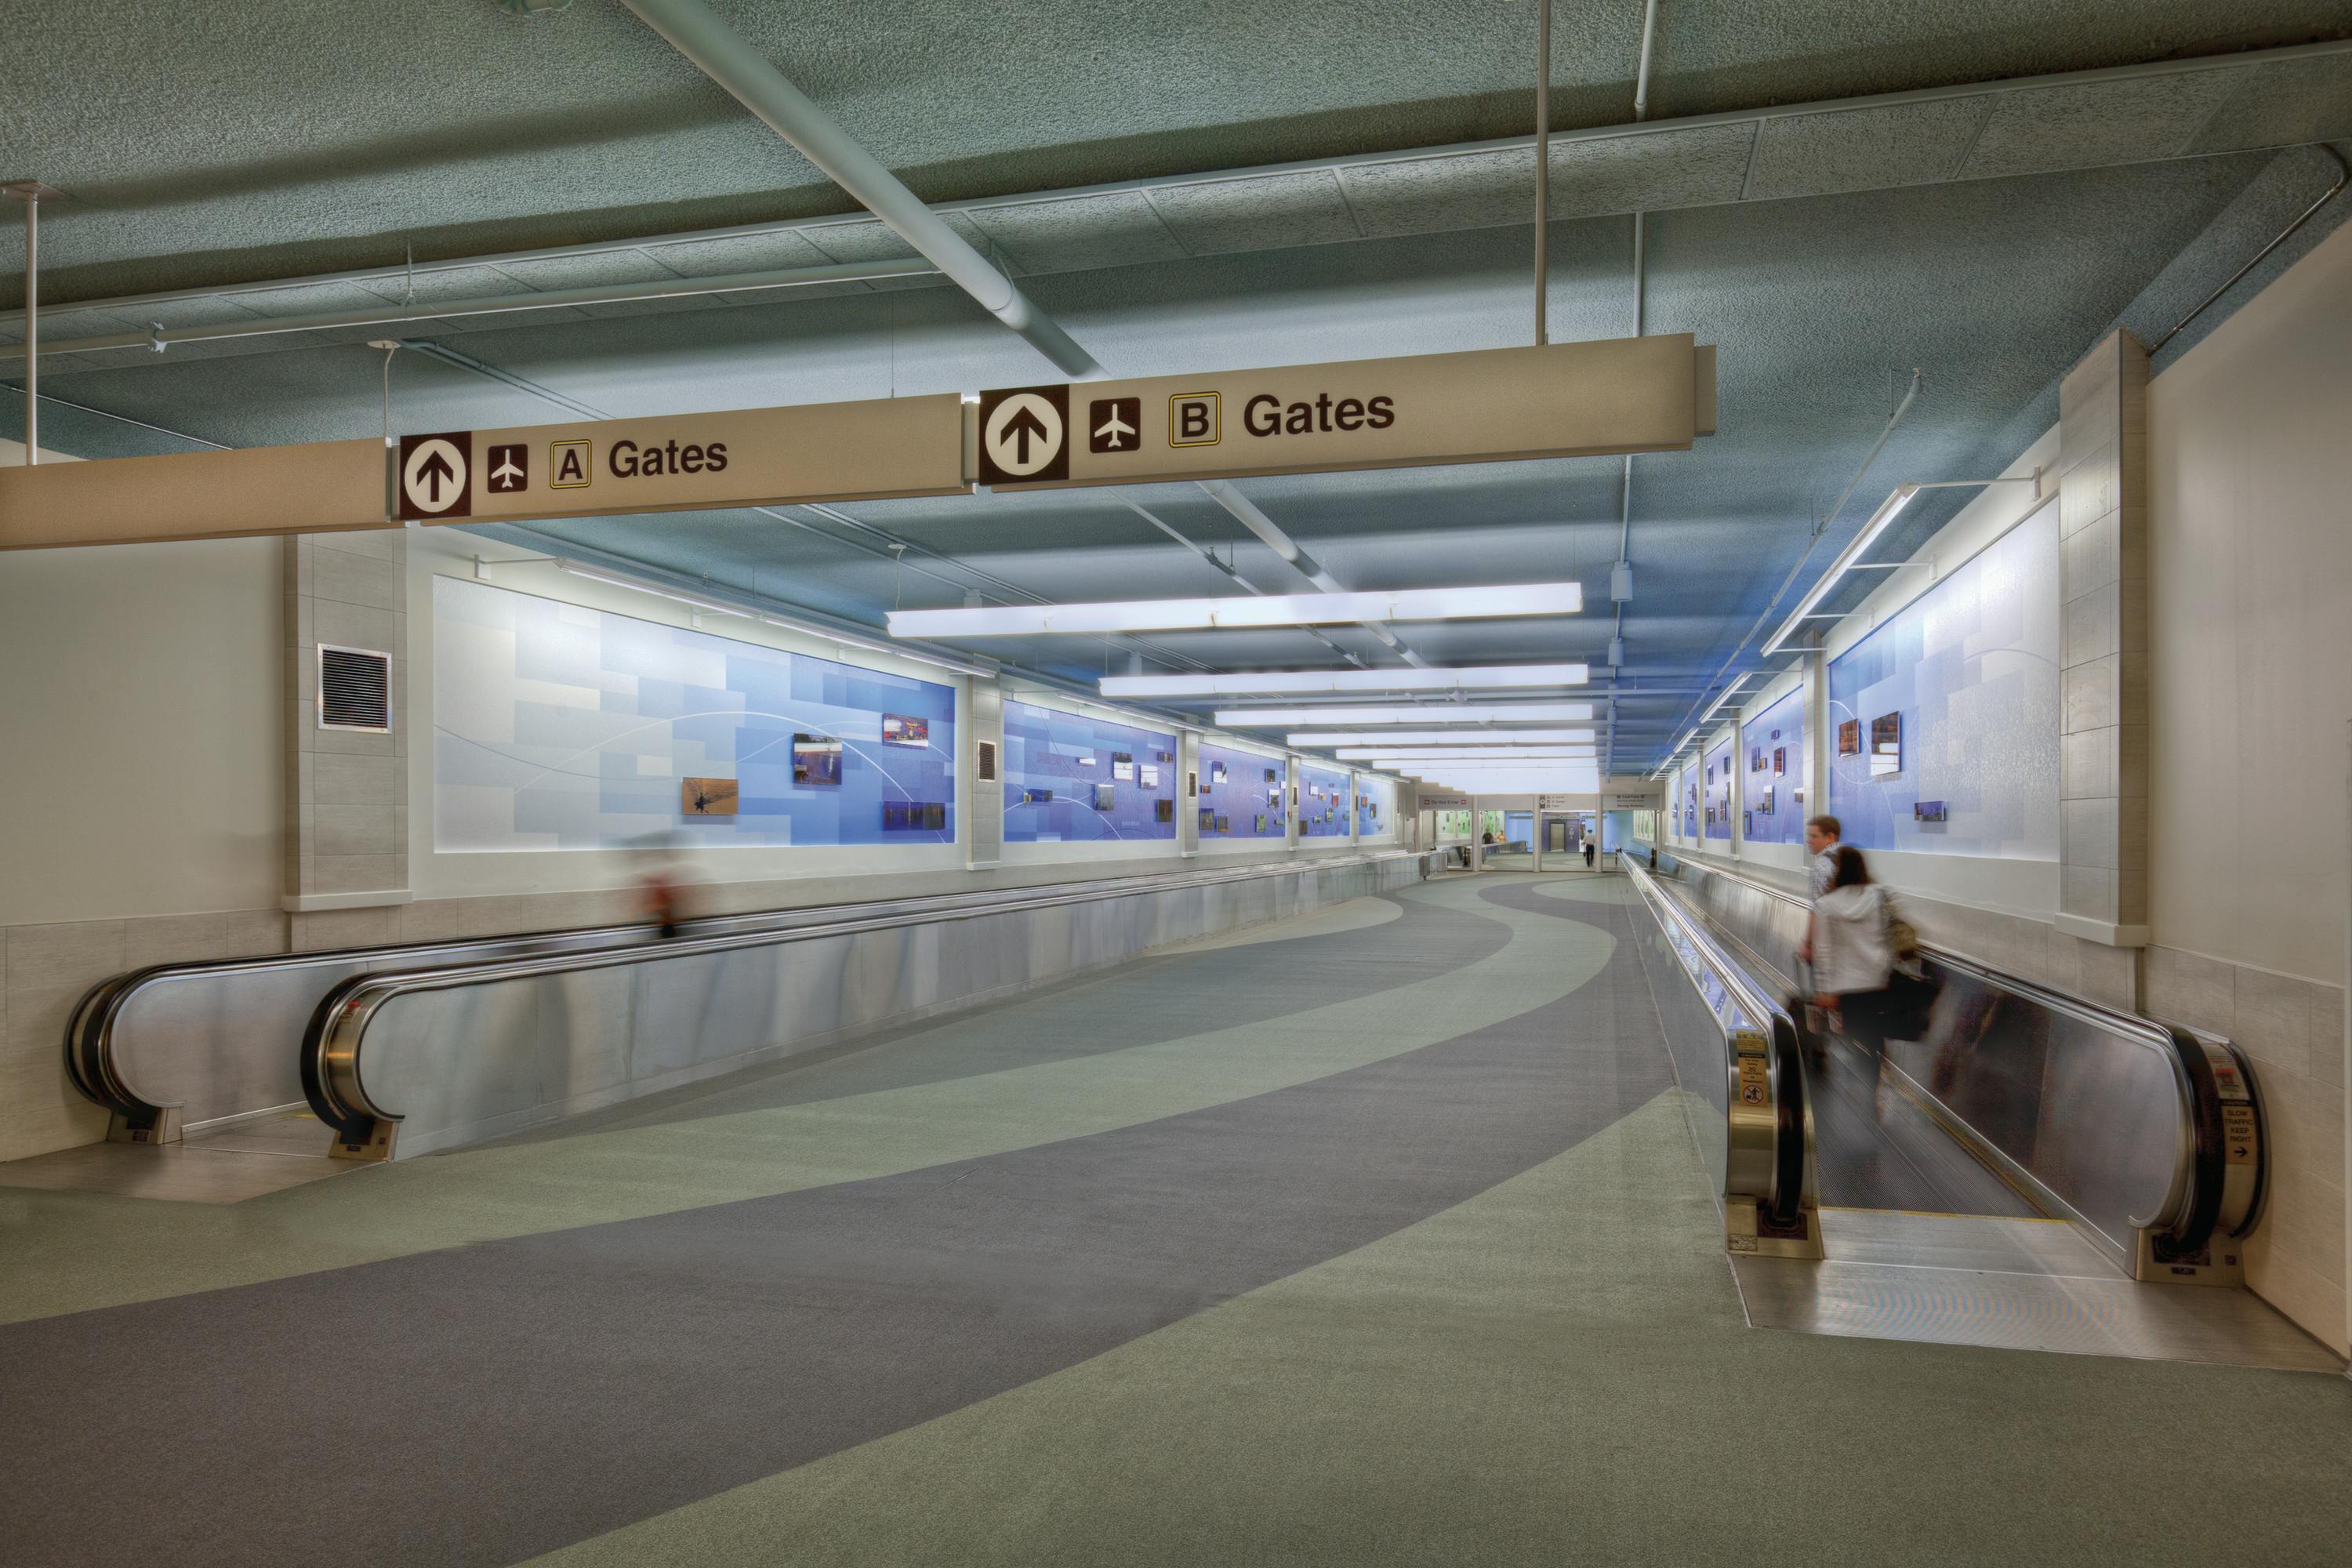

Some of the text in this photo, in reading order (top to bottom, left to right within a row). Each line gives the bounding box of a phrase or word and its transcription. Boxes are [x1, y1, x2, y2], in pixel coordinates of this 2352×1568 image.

[1181, 392, 1396, 438] B Gates
[557, 439, 728, 481] A Gates
